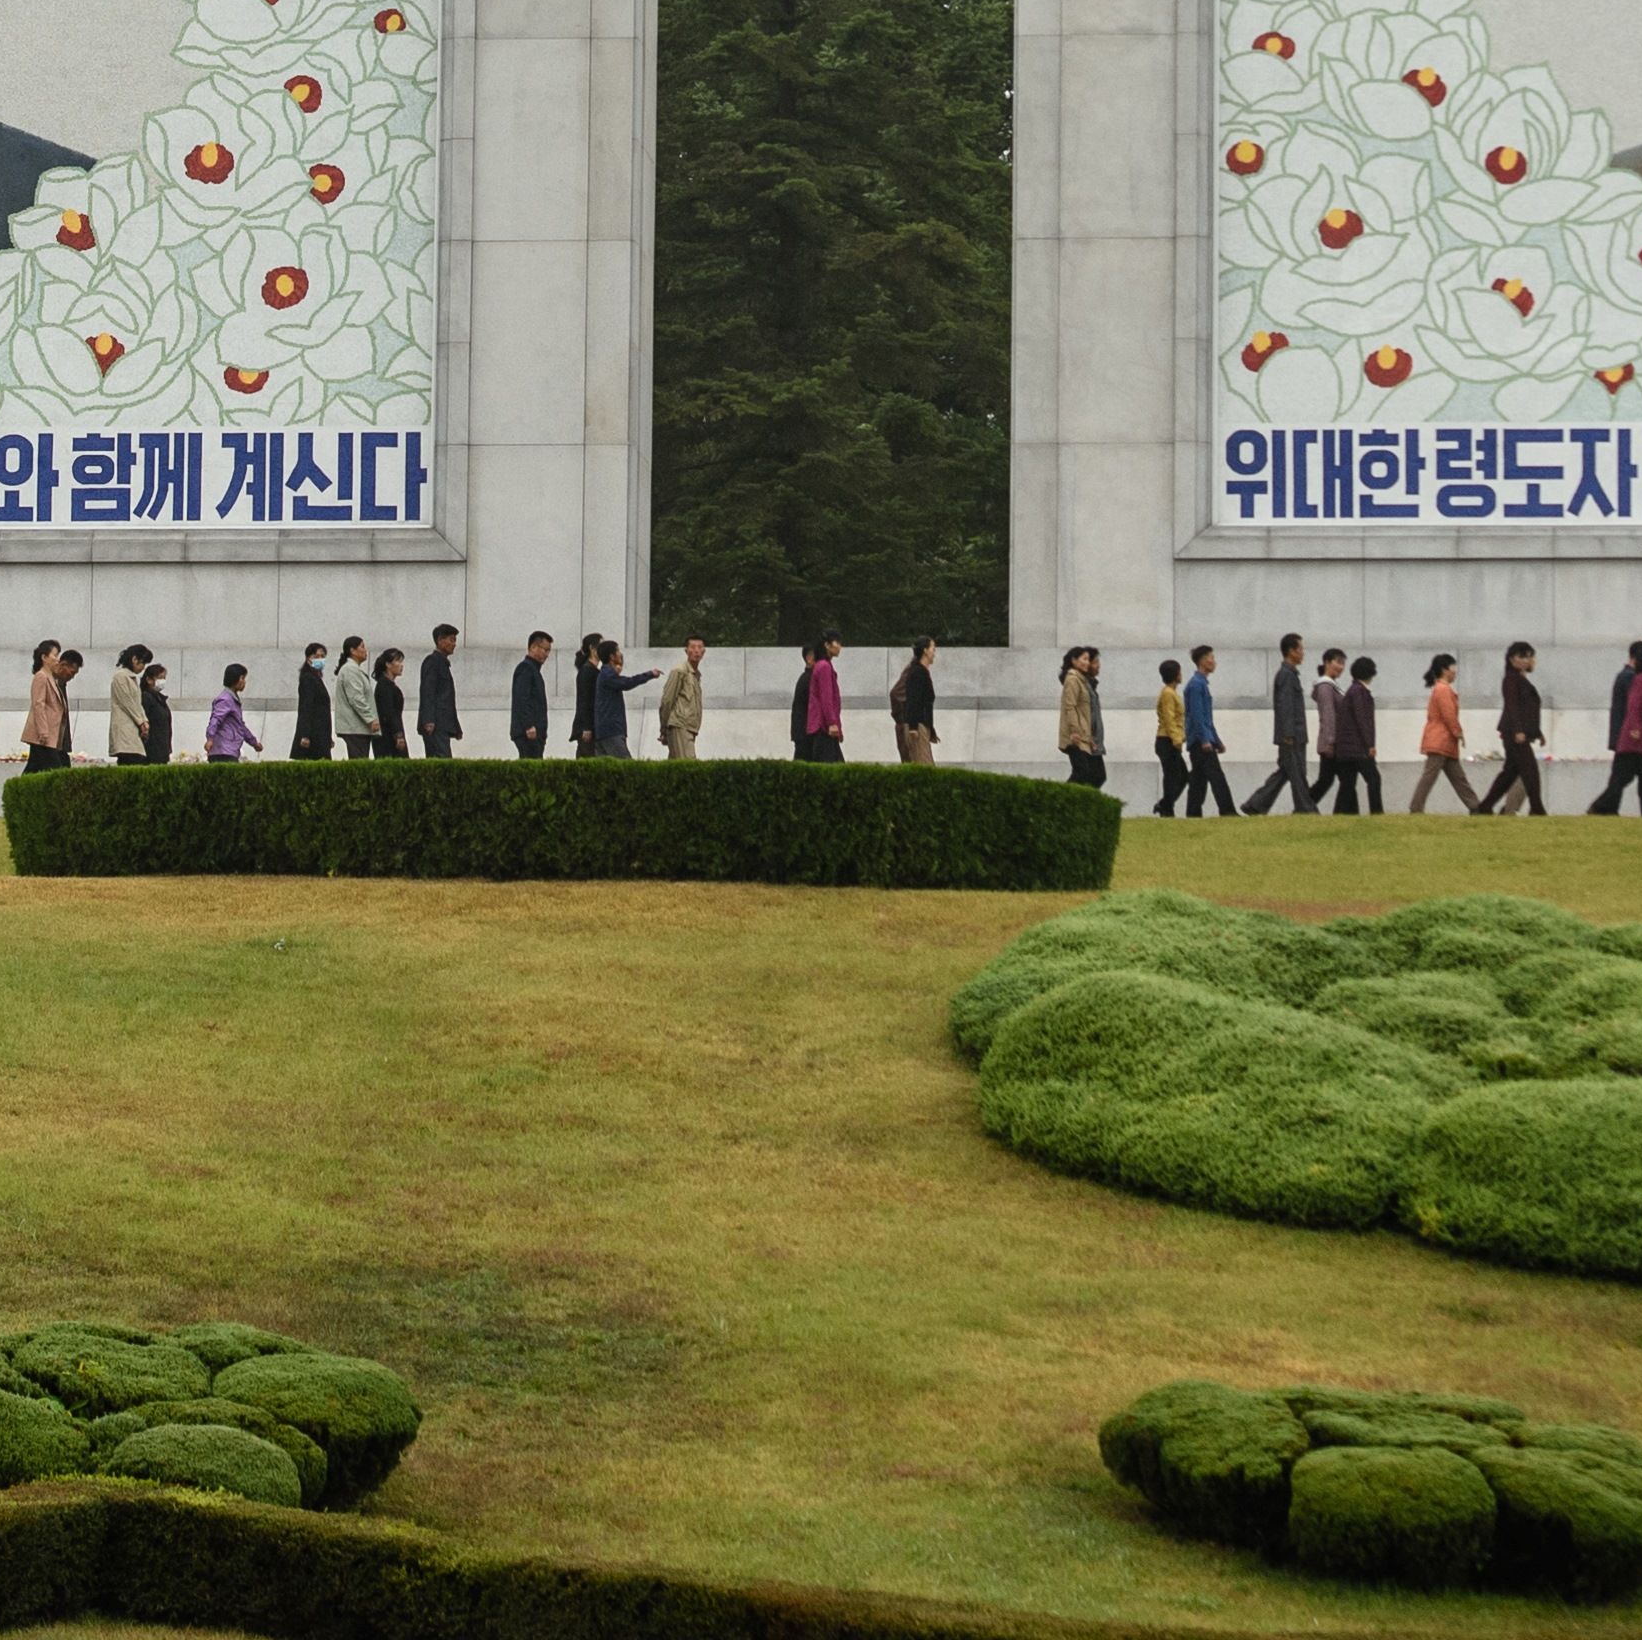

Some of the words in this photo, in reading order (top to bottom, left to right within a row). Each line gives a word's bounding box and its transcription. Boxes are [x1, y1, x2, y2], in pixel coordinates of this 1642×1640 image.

[71, 433, 203, 521] 함께
[216, 432, 427, 521] 계신다
[1226, 429, 1426, 518] 위대한
[1436, 429, 1638, 517] 령도자
